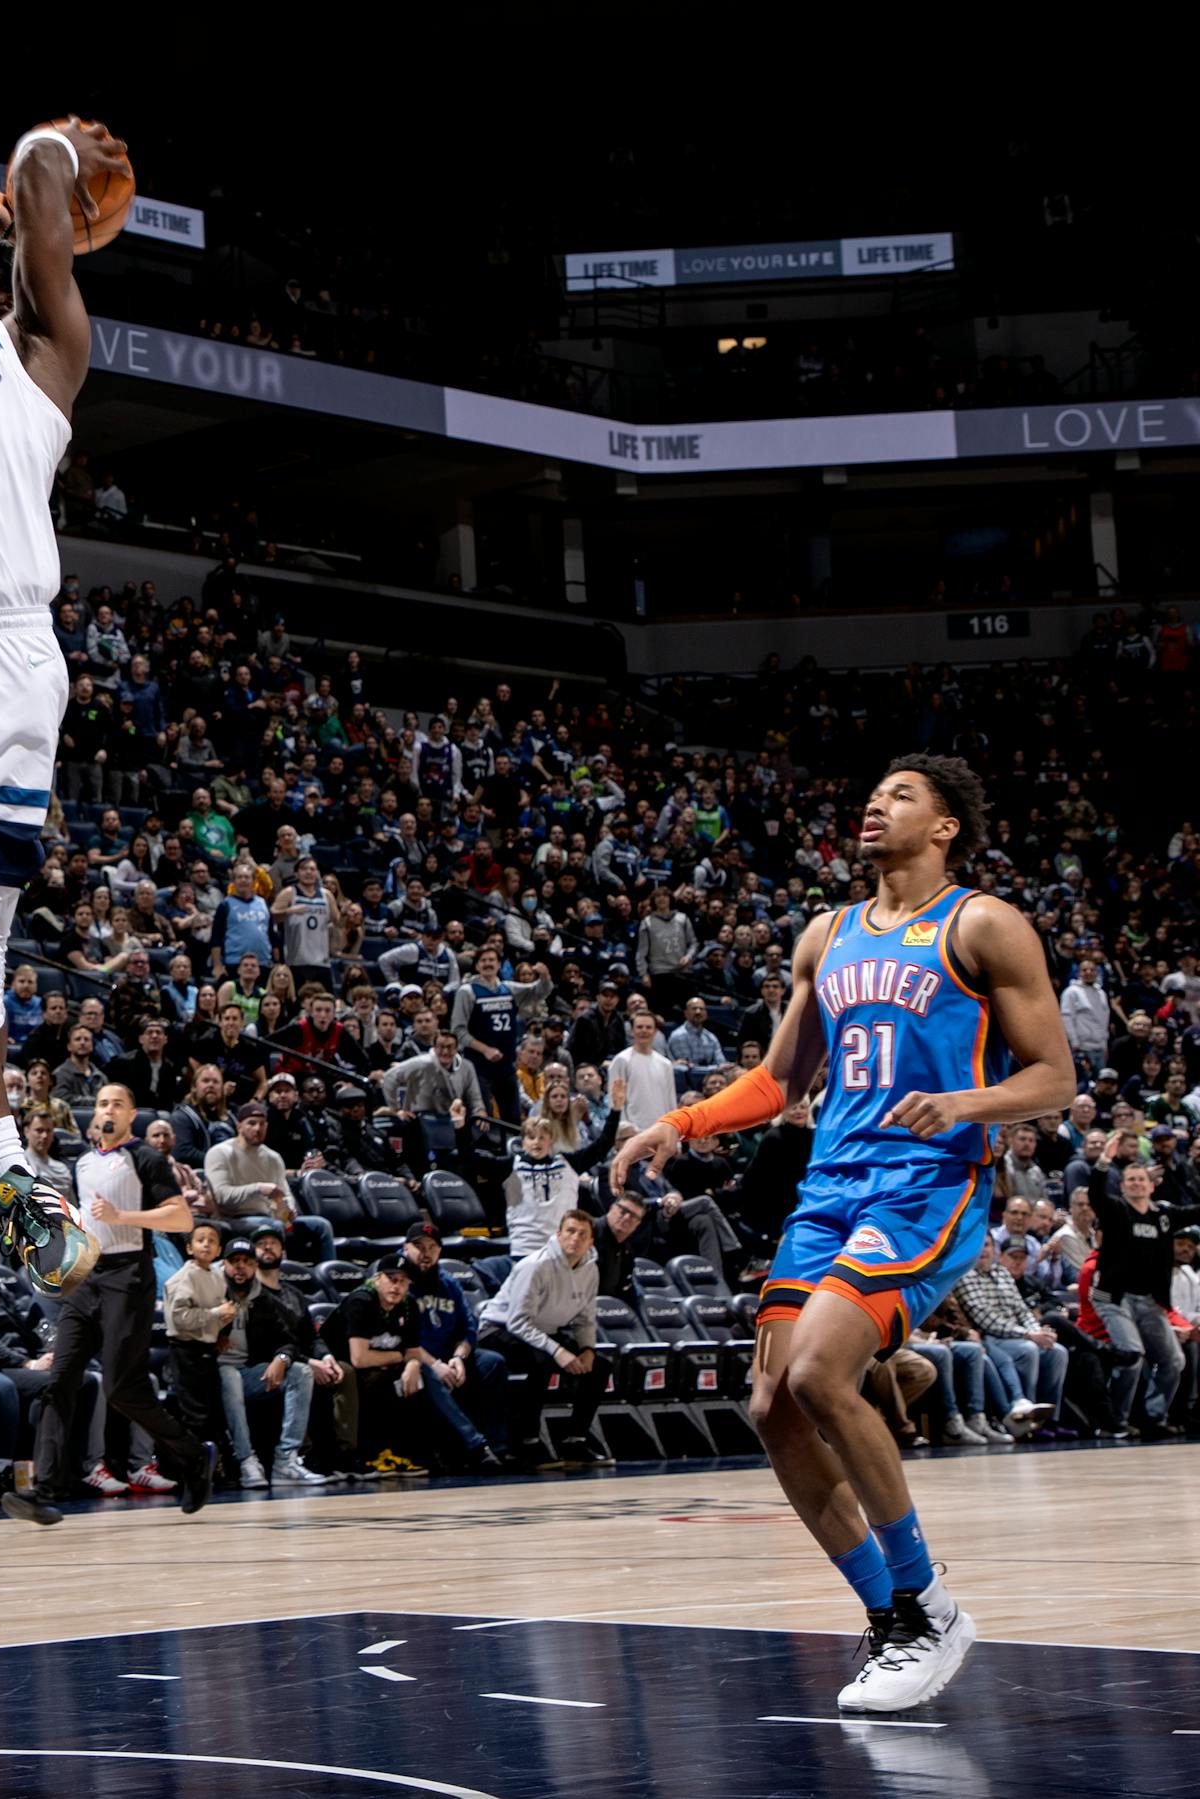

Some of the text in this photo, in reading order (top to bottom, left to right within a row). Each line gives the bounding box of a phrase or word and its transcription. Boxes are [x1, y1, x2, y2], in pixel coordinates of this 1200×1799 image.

[135, 196, 191, 234] LIFE TIME
[615, 259, 658, 278] TIME
[681, 251, 834, 274] LOVE YOUR LIFE
[857, 243, 934, 265] LIFE TIME
[163, 337, 283, 397] YOUR
[1022, 404, 1166, 448] LOVE
[609, 430, 701, 461] LIFE TIME
[969, 614, 1010, 636] 116
[818, 959, 942, 1022] THUNDER
[490, 1012, 512, 1032] 32
[841, 1020, 896, 1092] 21
